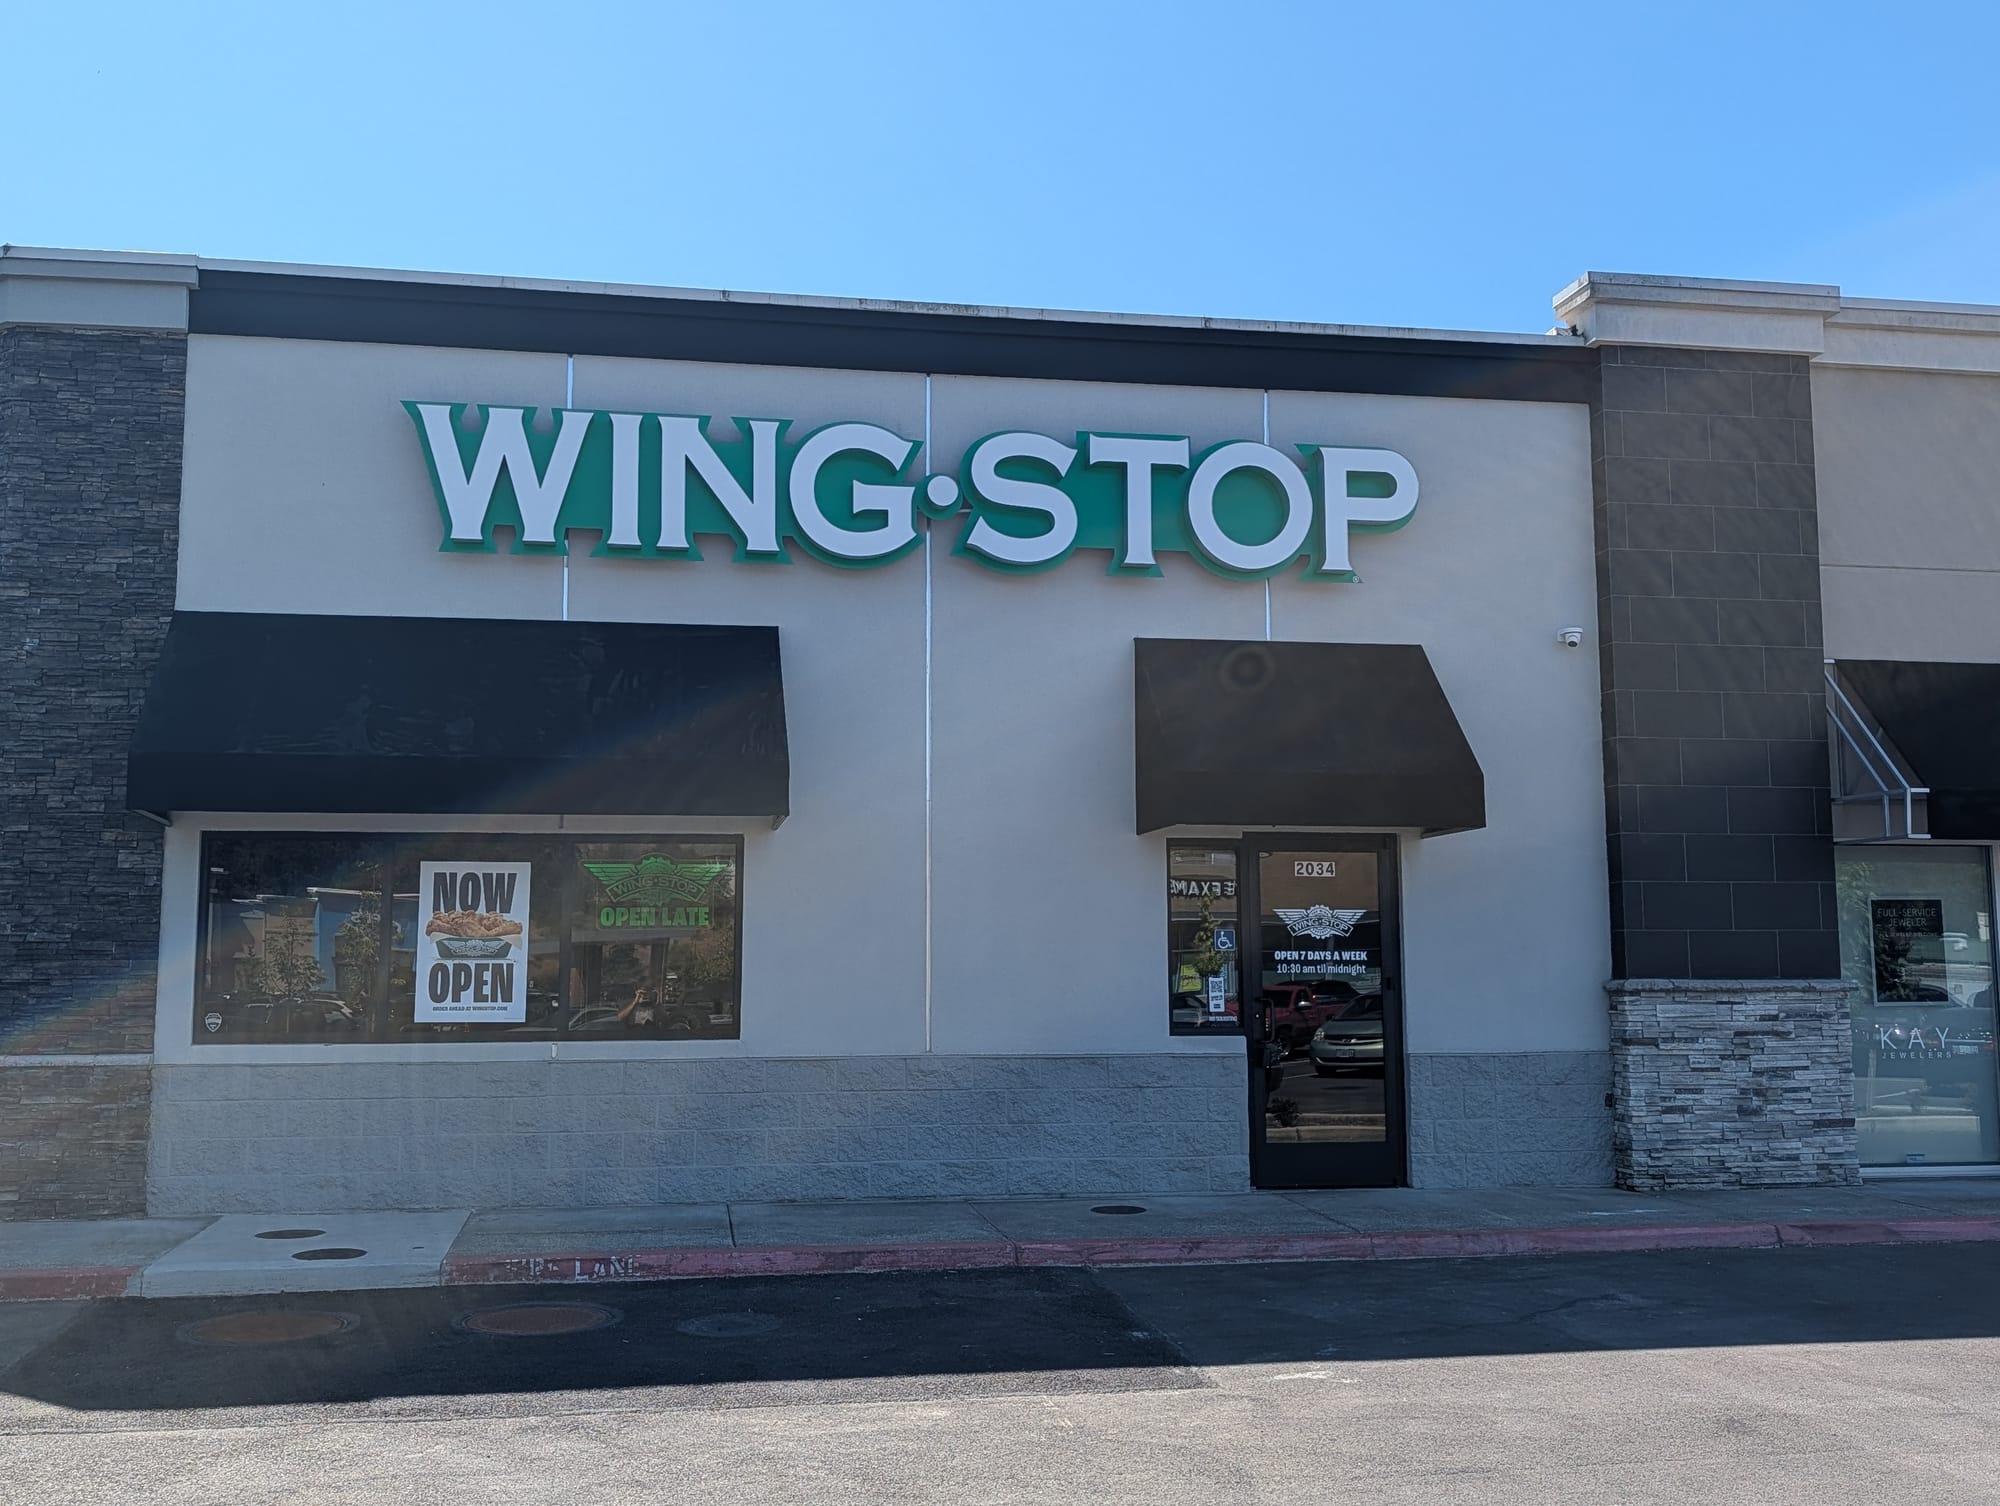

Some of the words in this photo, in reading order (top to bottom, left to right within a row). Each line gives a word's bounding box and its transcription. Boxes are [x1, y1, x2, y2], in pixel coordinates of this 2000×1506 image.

[1296, 862, 1335, 876] 2034
[432, 871, 518, 914] NOW
[600, 907, 656, 926] OPEN
[661, 907, 709, 926] LATE
[1877, 907, 1937, 917] FULL-SERVICE
[1888, 917, 1927, 927] JEWELER
[1274, 950, 1299, 960] OPEN
[1300, 951, 1306, 960] 7
[1307, 951, 1332, 960] DAYS
[1333, 951, 1340, 960] A
[1341, 951, 1368, 960] WEEK
[1276, 963, 1301, 974] 10:30
[1302, 965, 1316, 973] am
[1316, 963, 1326, 974] til
[1327, 963, 1366, 976] midnight
[428, 962, 514, 1003] OPEN
[1880, 1027, 1949, 1049] KAY
[1882, 1051, 1952, 1059] JEWELERS
